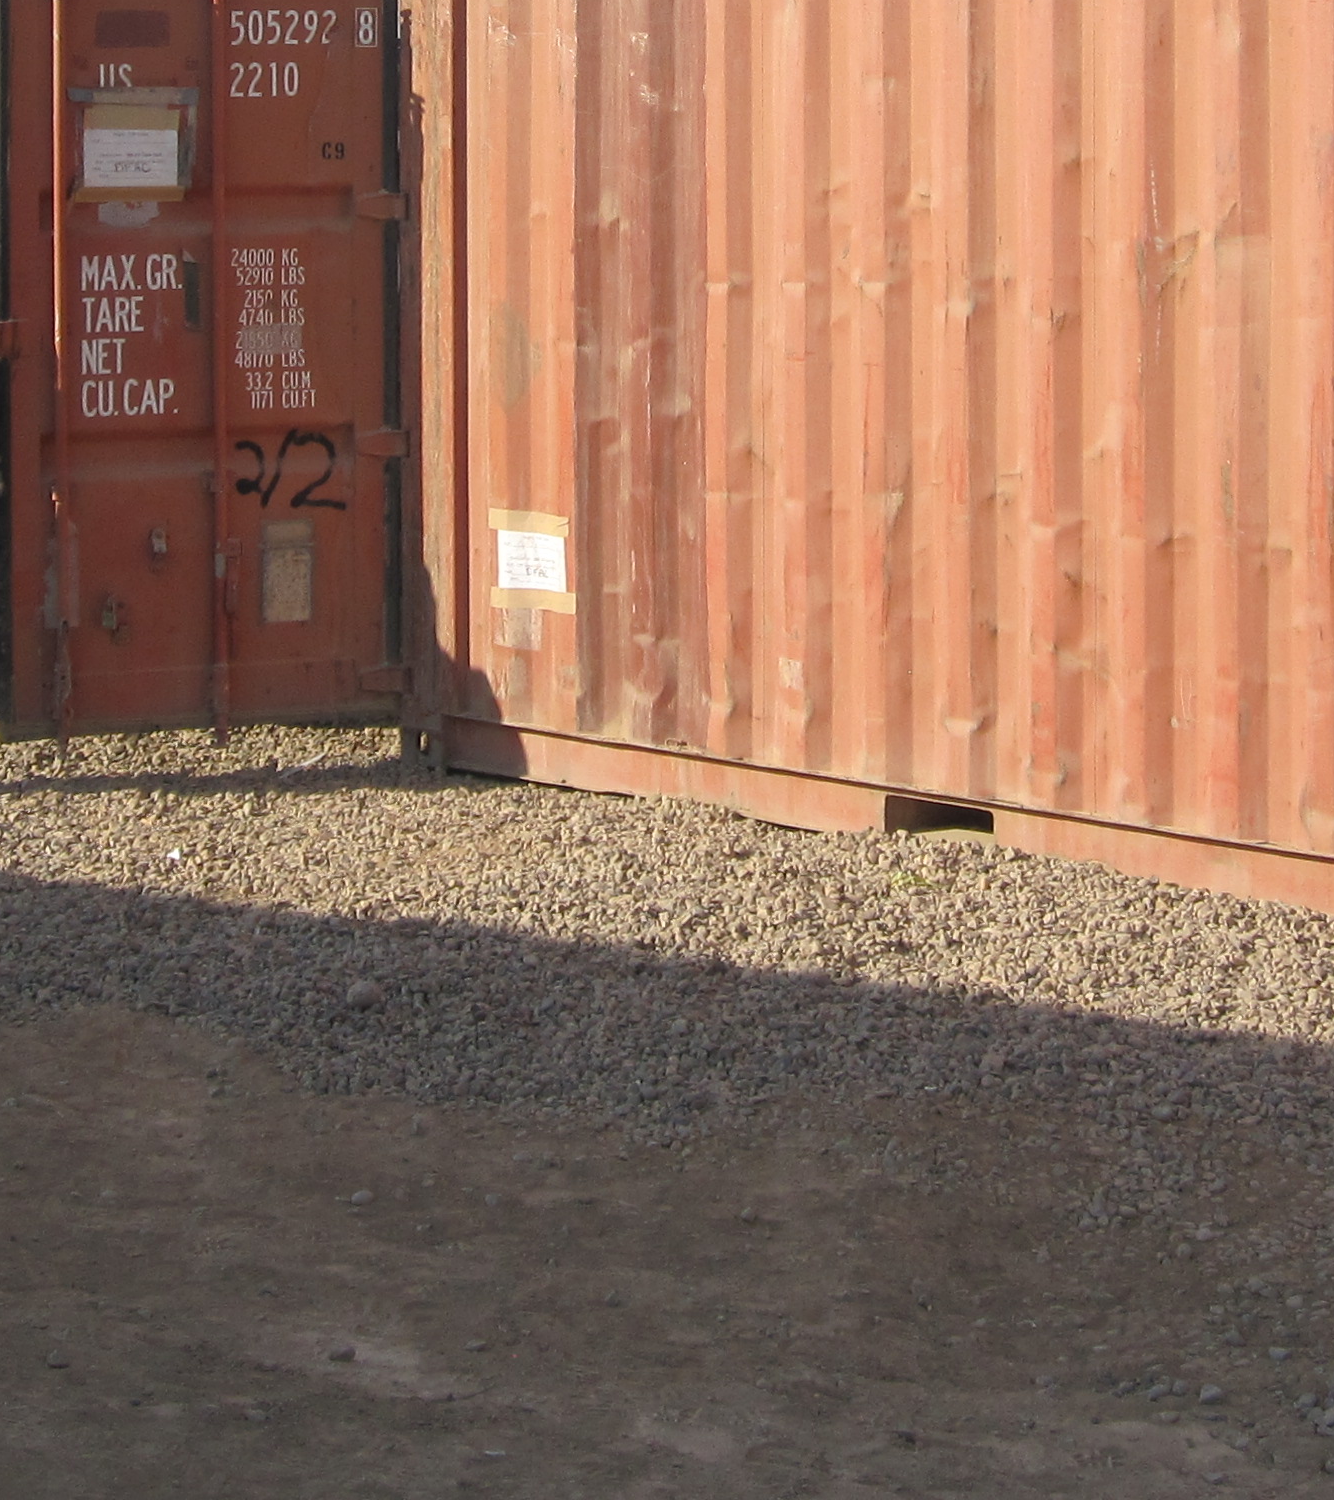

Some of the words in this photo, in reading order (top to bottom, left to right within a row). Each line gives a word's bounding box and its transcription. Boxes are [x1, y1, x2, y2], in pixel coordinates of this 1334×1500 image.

[230, 9, 338, 46] 505292
[358, 10, 375, 45] 8
[229, 62, 300, 98] 2210
[321, 141, 346, 160] C9
[231, 248, 275, 267] 24000
[281, 248, 299, 266] KG
[80, 254, 142, 292] MAX.
[145, 253, 183, 290] GR.
[236, 267, 274, 286] 52910
[281, 266, 305, 285] LBS
[281, 289, 299, 308] KG
[82, 296, 145, 333] TARE
[238, 308, 273, 326] 4740
[281, 307, 305, 326] LBS
[81, 338, 126, 376] NET
[281, 348, 306, 368] LBS
[245, 372, 273, 391] 33.2
[81, 380, 119, 418] CU.
[123, 378, 179, 416] CAP.
[251, 390, 273, 410] 1171
